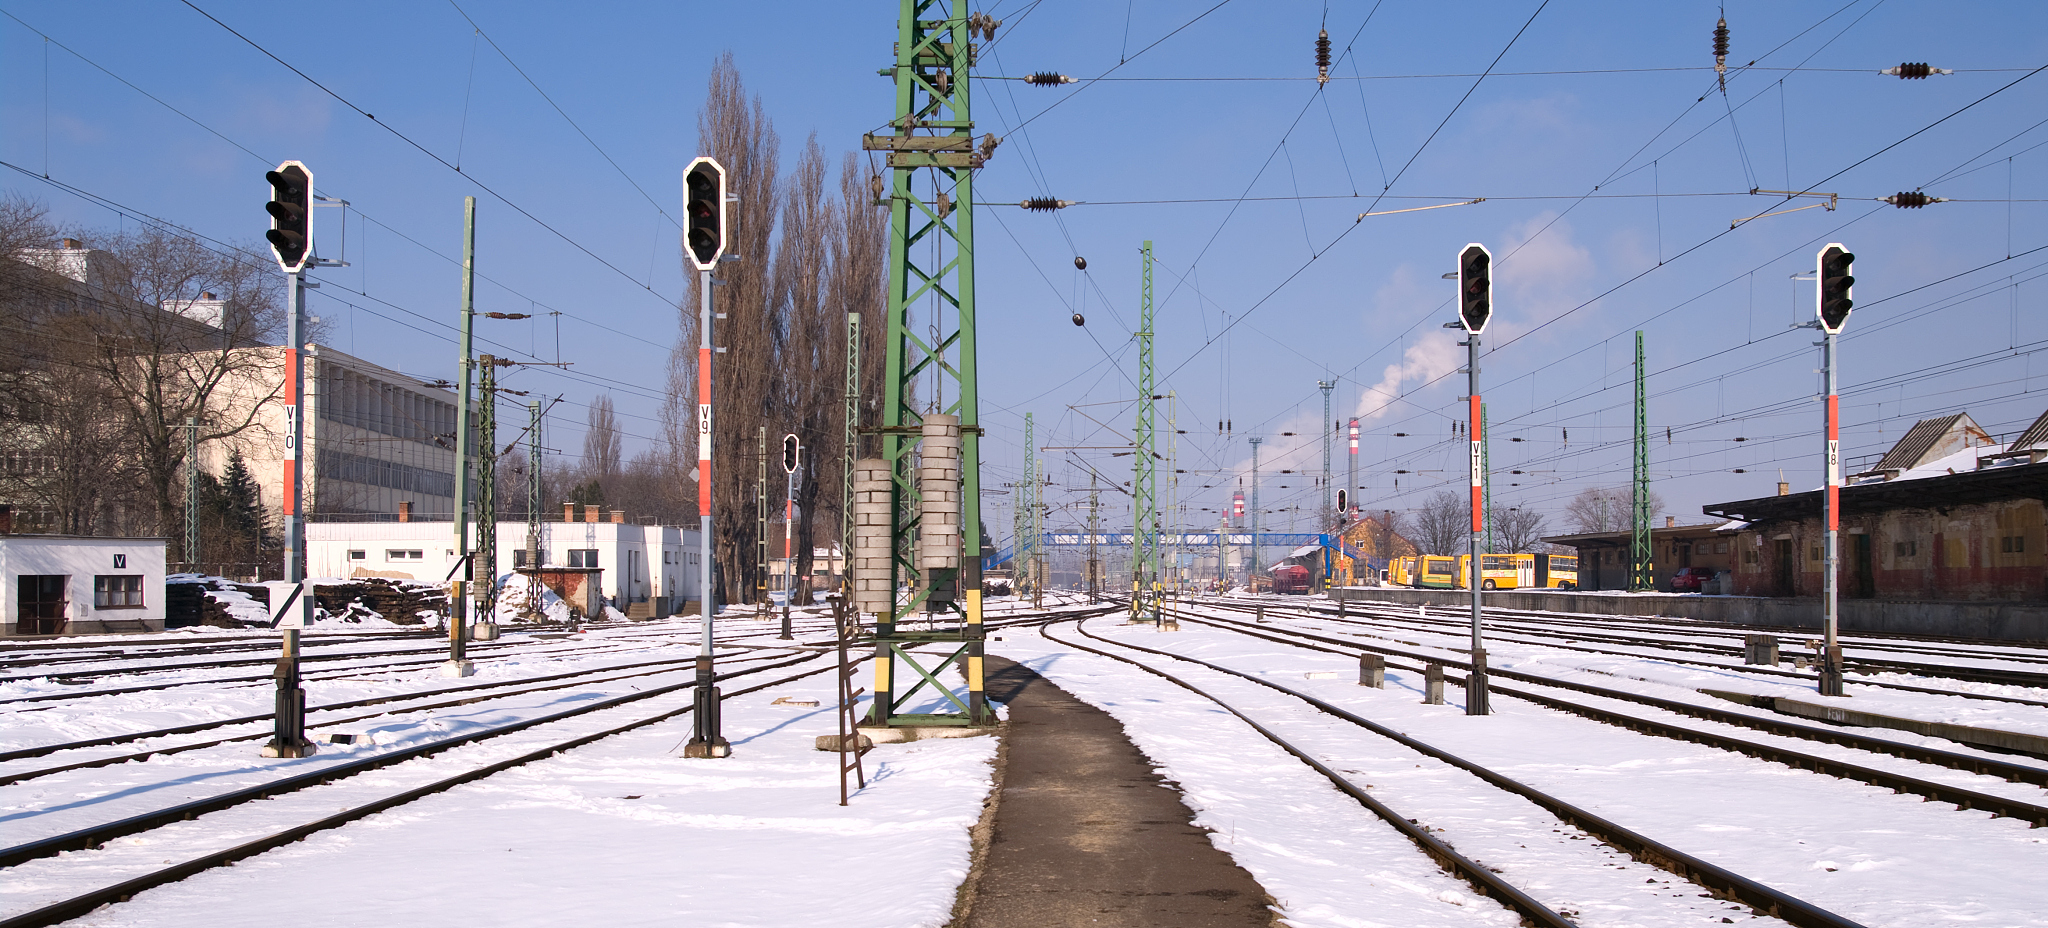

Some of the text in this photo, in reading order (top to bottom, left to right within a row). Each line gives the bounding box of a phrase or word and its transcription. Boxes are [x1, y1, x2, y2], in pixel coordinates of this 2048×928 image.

[285, 407, 294, 449] V10
[702, 407, 709, 434] V9
[1830, 443, 1837, 465] V8
[115, 555, 125, 567] V
